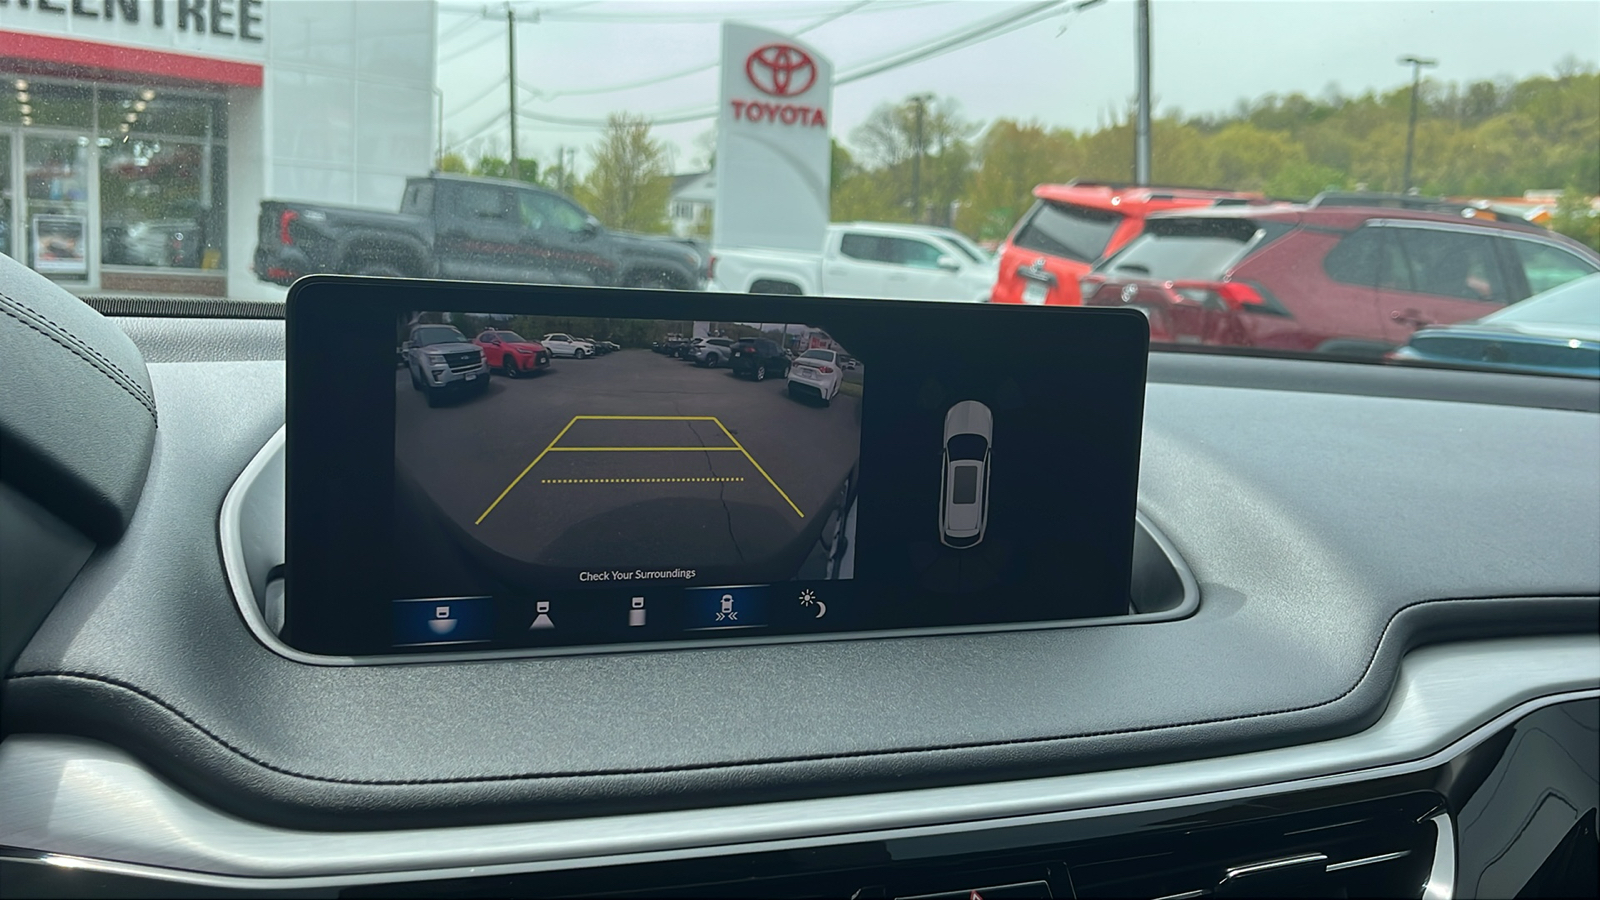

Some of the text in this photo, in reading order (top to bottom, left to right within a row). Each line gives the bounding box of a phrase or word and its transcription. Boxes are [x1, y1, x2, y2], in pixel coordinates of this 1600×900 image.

[0, 0, 263, 41] NTREE
[731, 100, 826, 127] TOYOTA
[579, 568, 696, 581] Check Your Surroundings
